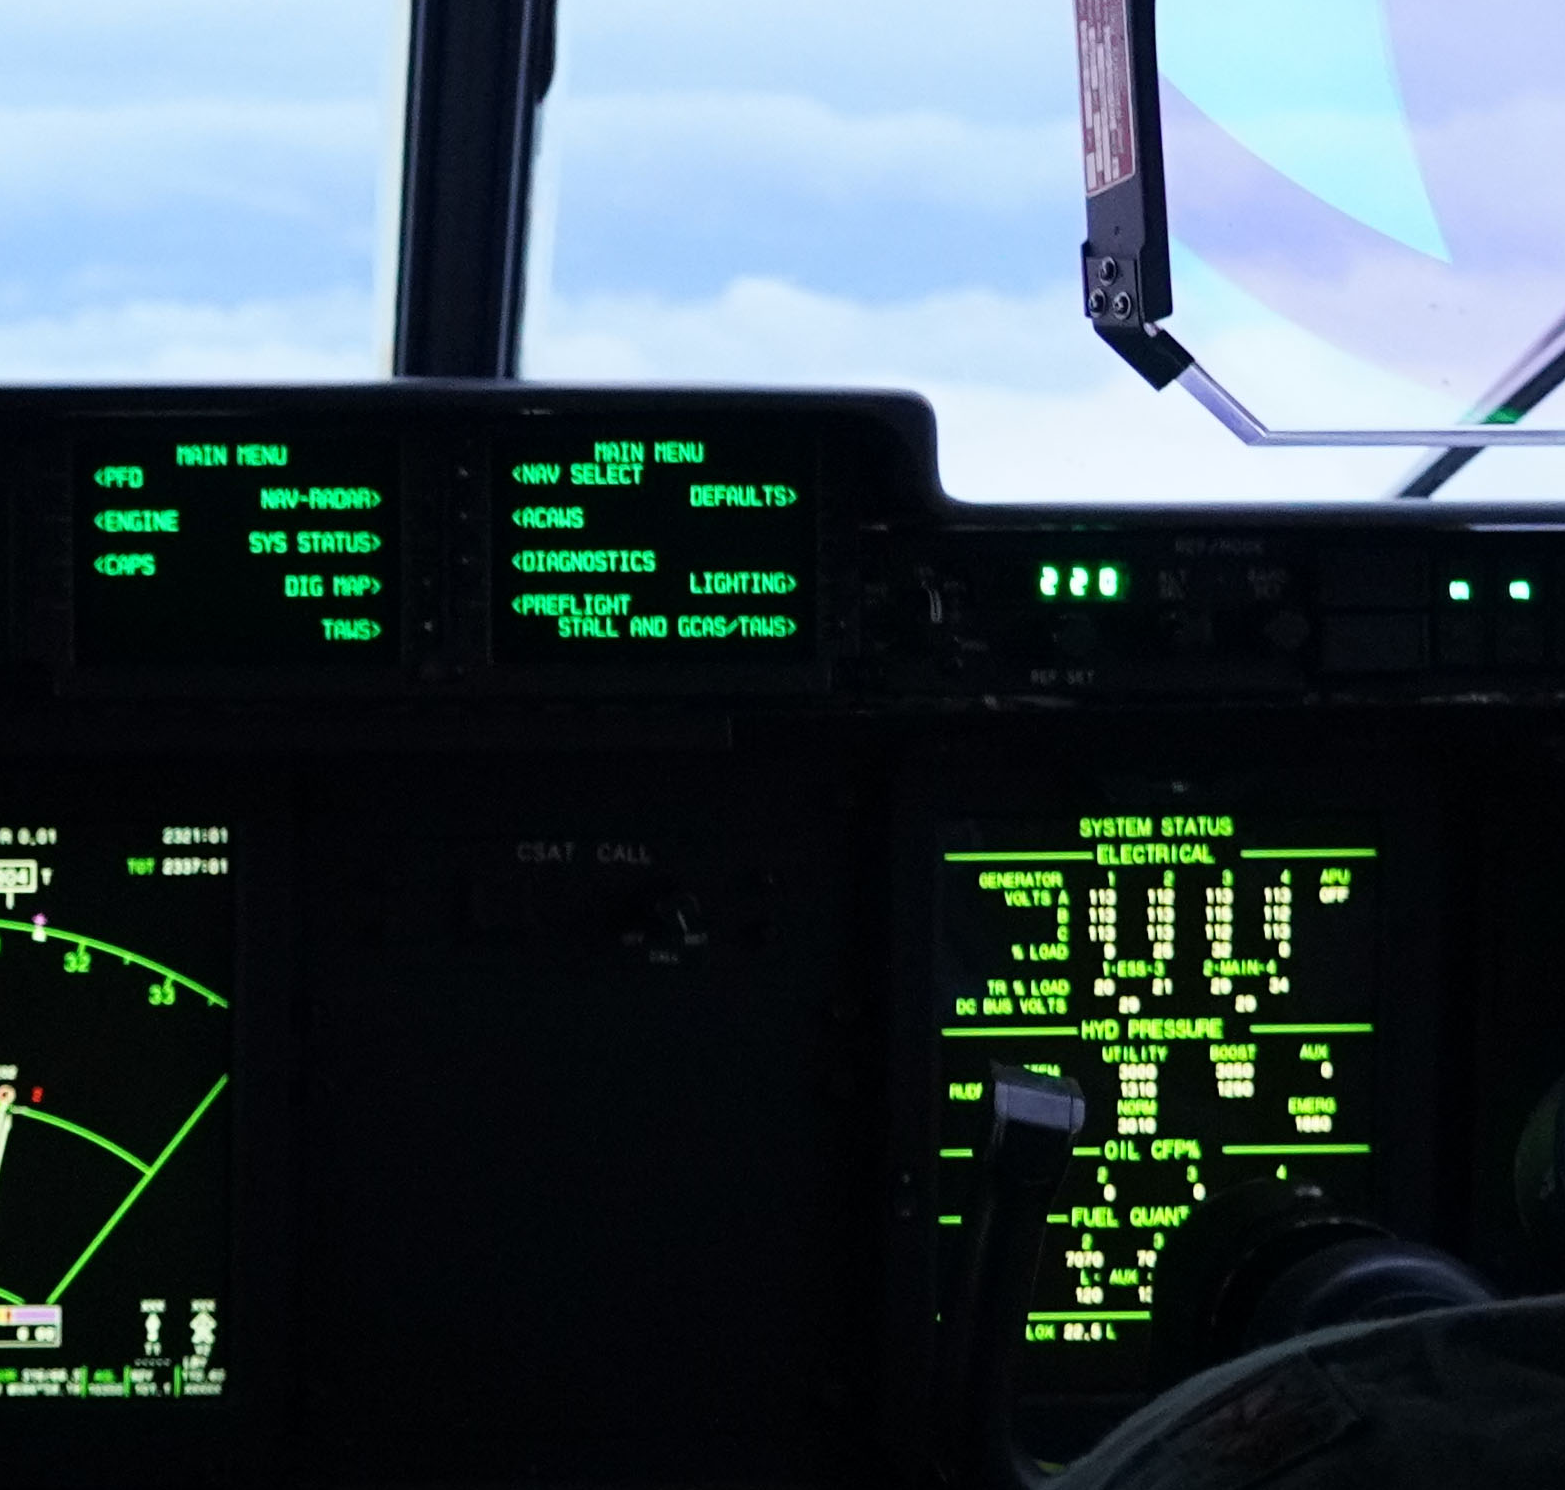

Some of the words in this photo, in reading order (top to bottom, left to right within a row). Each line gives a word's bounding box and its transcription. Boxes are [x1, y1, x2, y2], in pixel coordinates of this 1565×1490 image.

[177, 445, 227, 466] MAIN
[237, 444, 287, 466] MENU
[594, 441, 645, 463] MAIN
[653, 441, 705, 463] MENU
[570, 463, 644, 485] SELECT
[249, 531, 287, 553] SYS
[285, 575, 323, 597] DIG
[557, 617, 620, 639] STALL
[629, 617, 667, 639] AND
[1080, 817, 1152, 837] SYSTEM
[1161, 816, 1233, 837] STATUS
[516, 843, 575, 863] CSAT
[596, 843, 652, 865] CALL
[1097, 844, 1215, 865] ELECTRICAL
[979, 872, 1063, 890] GENERATOR
[1106, 870, 1115, 887] 1
[1280, 869, 1291, 885] 4
[1320, 868, 1351, 885] APU
[1005, 890, 1052, 907] VOLTS
[1057, 889, 1069, 907] A
[1030, 944, 1069, 961] LOAD
[987, 980, 1007, 997] TR
[1030, 979, 1069, 996] LOAD
[956, 998, 977, 1015] DC
[983, 998, 1013, 1015] BUS
[1019, 998, 1067, 1014] VOLTS
[1081, 1020, 1119, 1040] HYD
[1128, 1019, 1224, 1039] PRESSURE
[1102, 1045, 1168, 1063] UTILITY
[1210, 1045, 1257, 1062] BOOST
[1300, 1044, 1329, 1060] AUX
[1117, 1100, 1158, 1117] NORM
[1288, 1097, 1337, 1114] EMERG
[1104, 1140, 1140, 1161] OIL
[1071, 1207, 1119, 1228] FUEL
[1066, 1250, 1104, 1268] 7070
[1109, 1269, 1138, 1285] AUX
[1026, 1324, 1056, 1341] LOX
